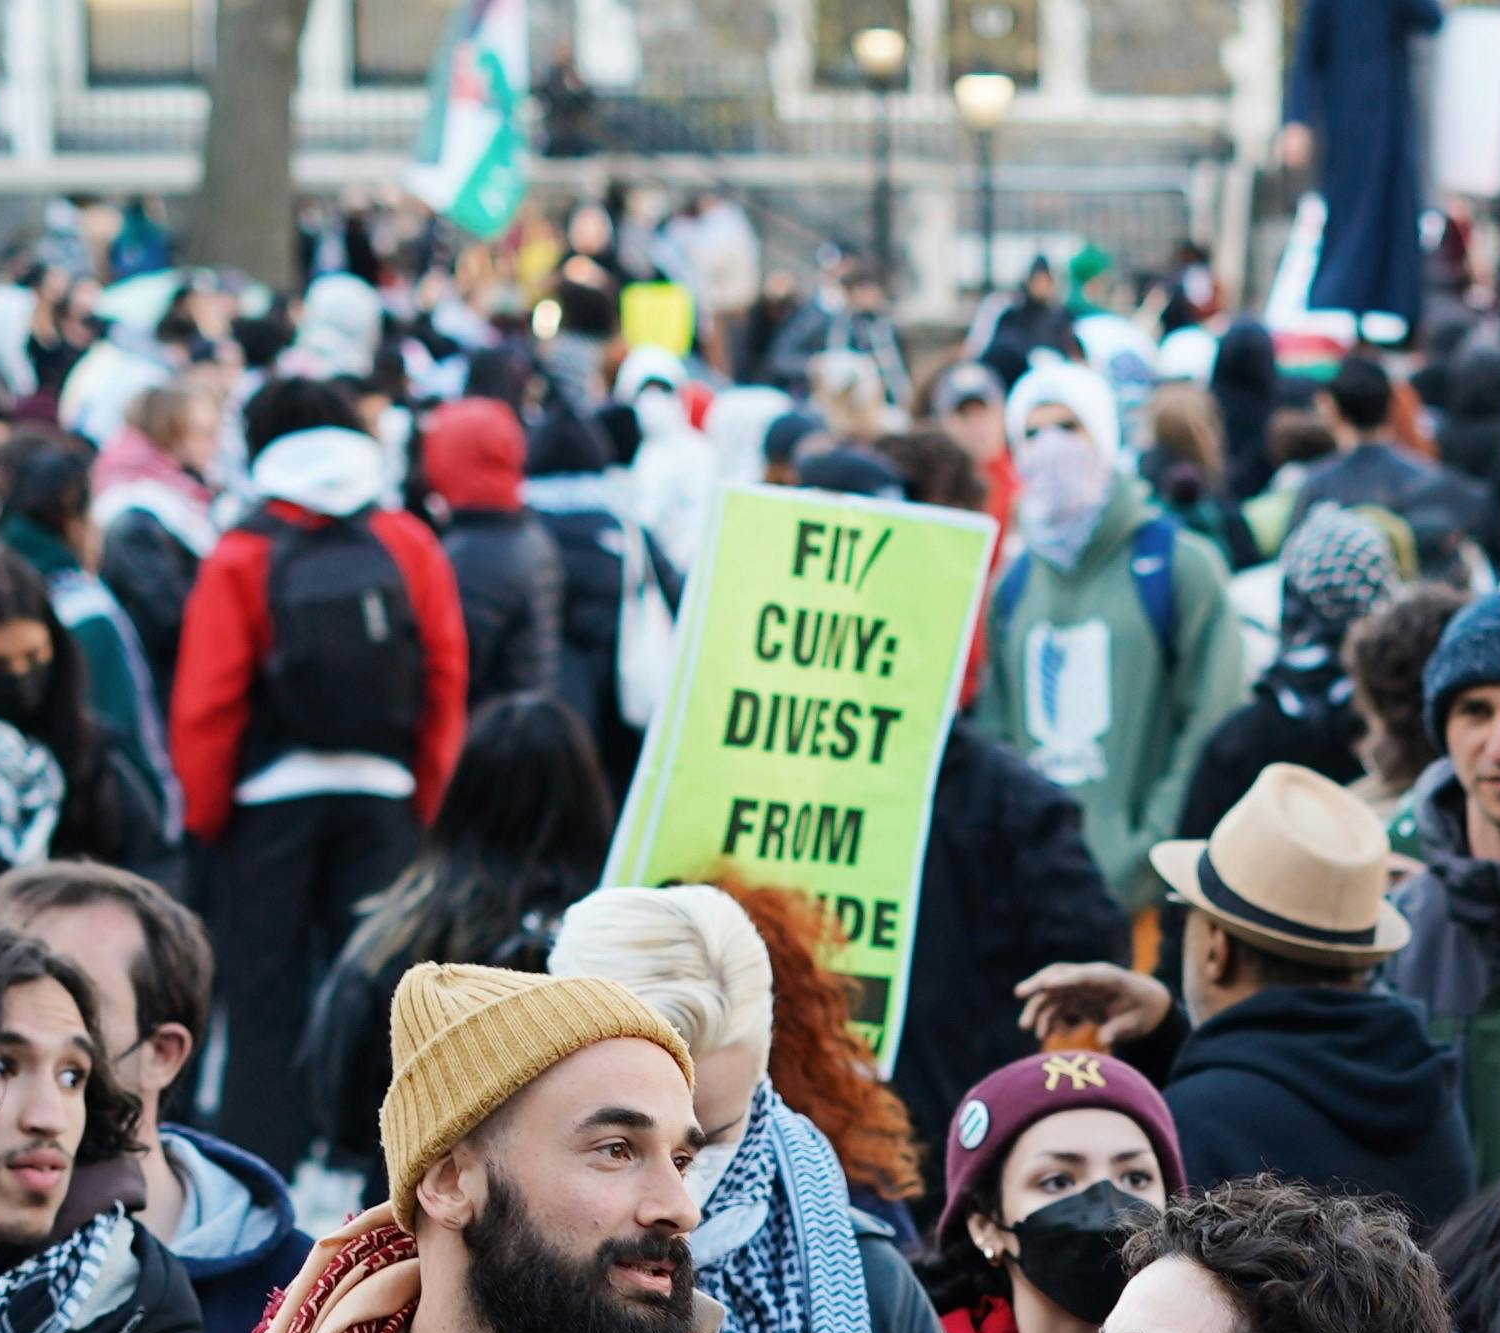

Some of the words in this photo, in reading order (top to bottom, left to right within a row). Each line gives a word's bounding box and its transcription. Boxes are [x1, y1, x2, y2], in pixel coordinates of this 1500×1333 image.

[791, 521, 894, 593] FIT/
[755, 604, 900, 677] CUNY:
[721, 689, 904, 764] DIVEST
[722, 798, 865, 867] FROM
